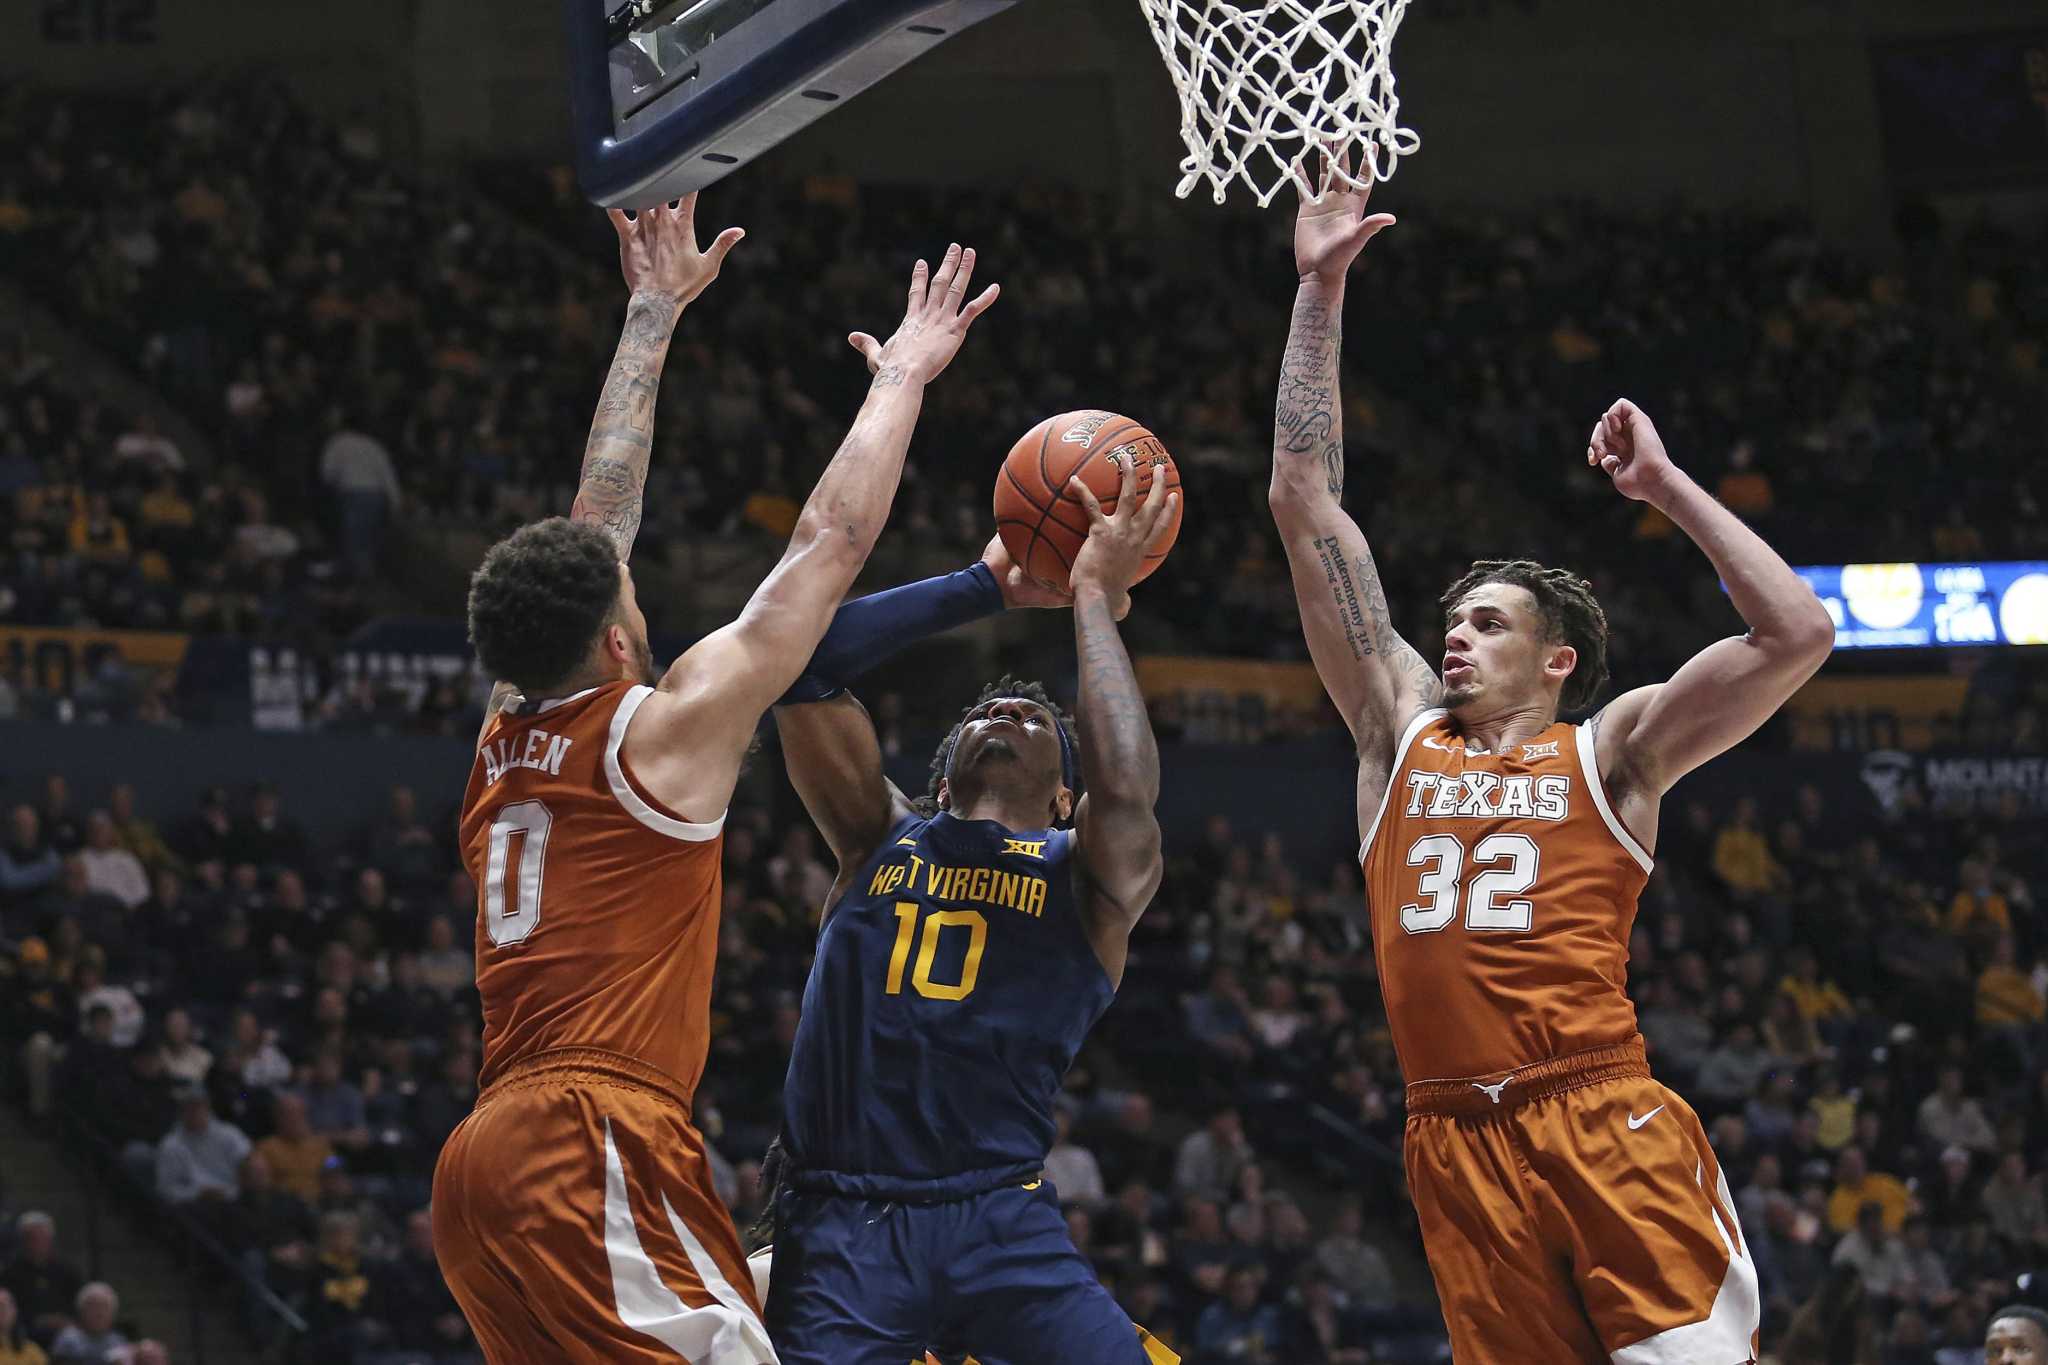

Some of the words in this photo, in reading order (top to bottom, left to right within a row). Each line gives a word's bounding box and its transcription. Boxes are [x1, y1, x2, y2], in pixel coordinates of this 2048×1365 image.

[481, 728, 573, 786] ALLEN
[1406, 769, 1570, 822] TEXAS
[484, 799, 553, 949] 0
[1001, 838, 1047, 859] XII
[927, 863, 1048, 918] VIRGINIA
[1400, 833, 1541, 935] 32
[885, 901, 988, 1001] 10
